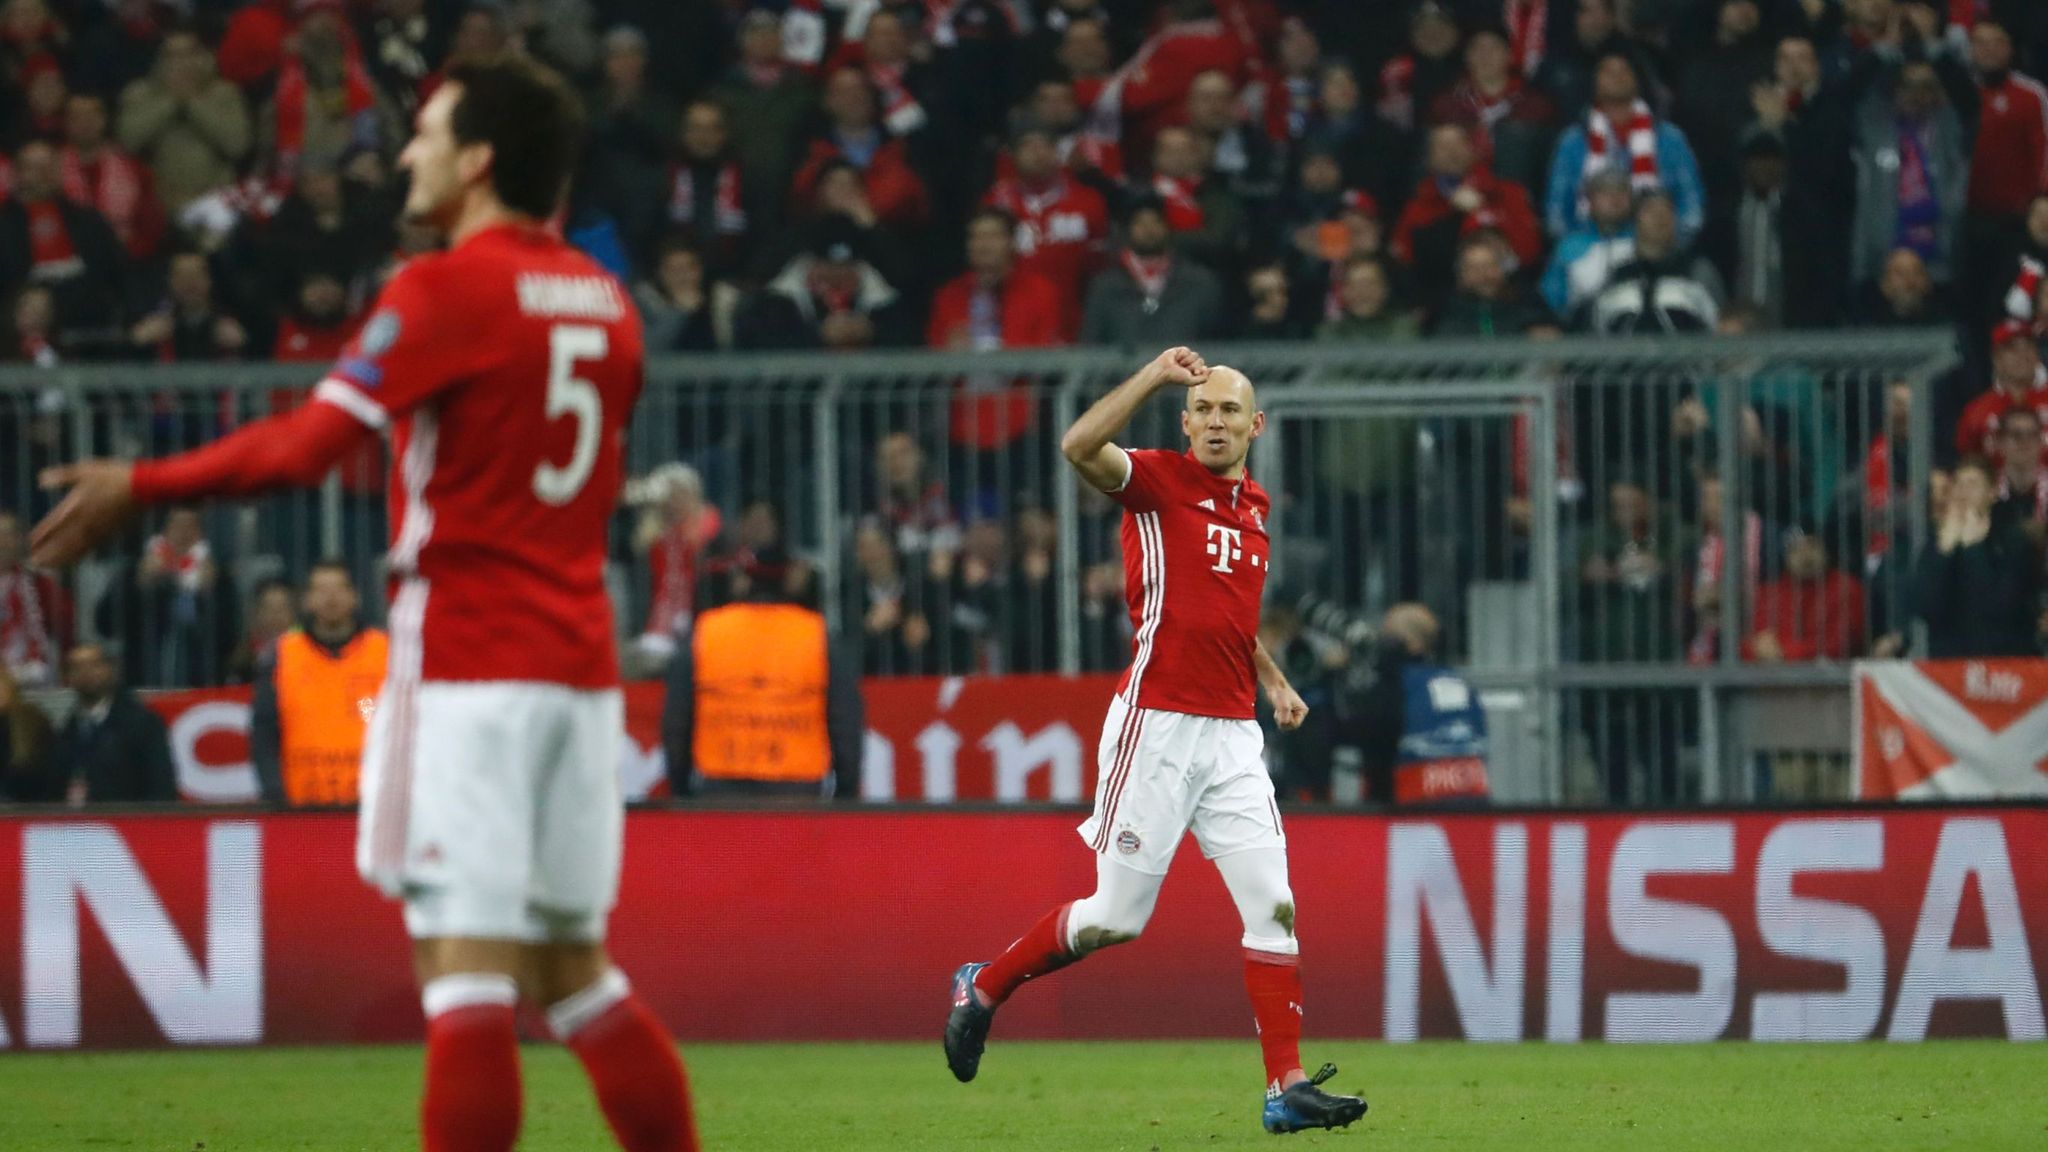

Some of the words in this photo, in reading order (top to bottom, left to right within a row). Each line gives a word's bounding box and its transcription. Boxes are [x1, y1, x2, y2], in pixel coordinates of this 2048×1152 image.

[533, 325, 608, 505] 5
[0, 820, 264, 1046] N
[1383, 817, 2047, 1042] NISSA
